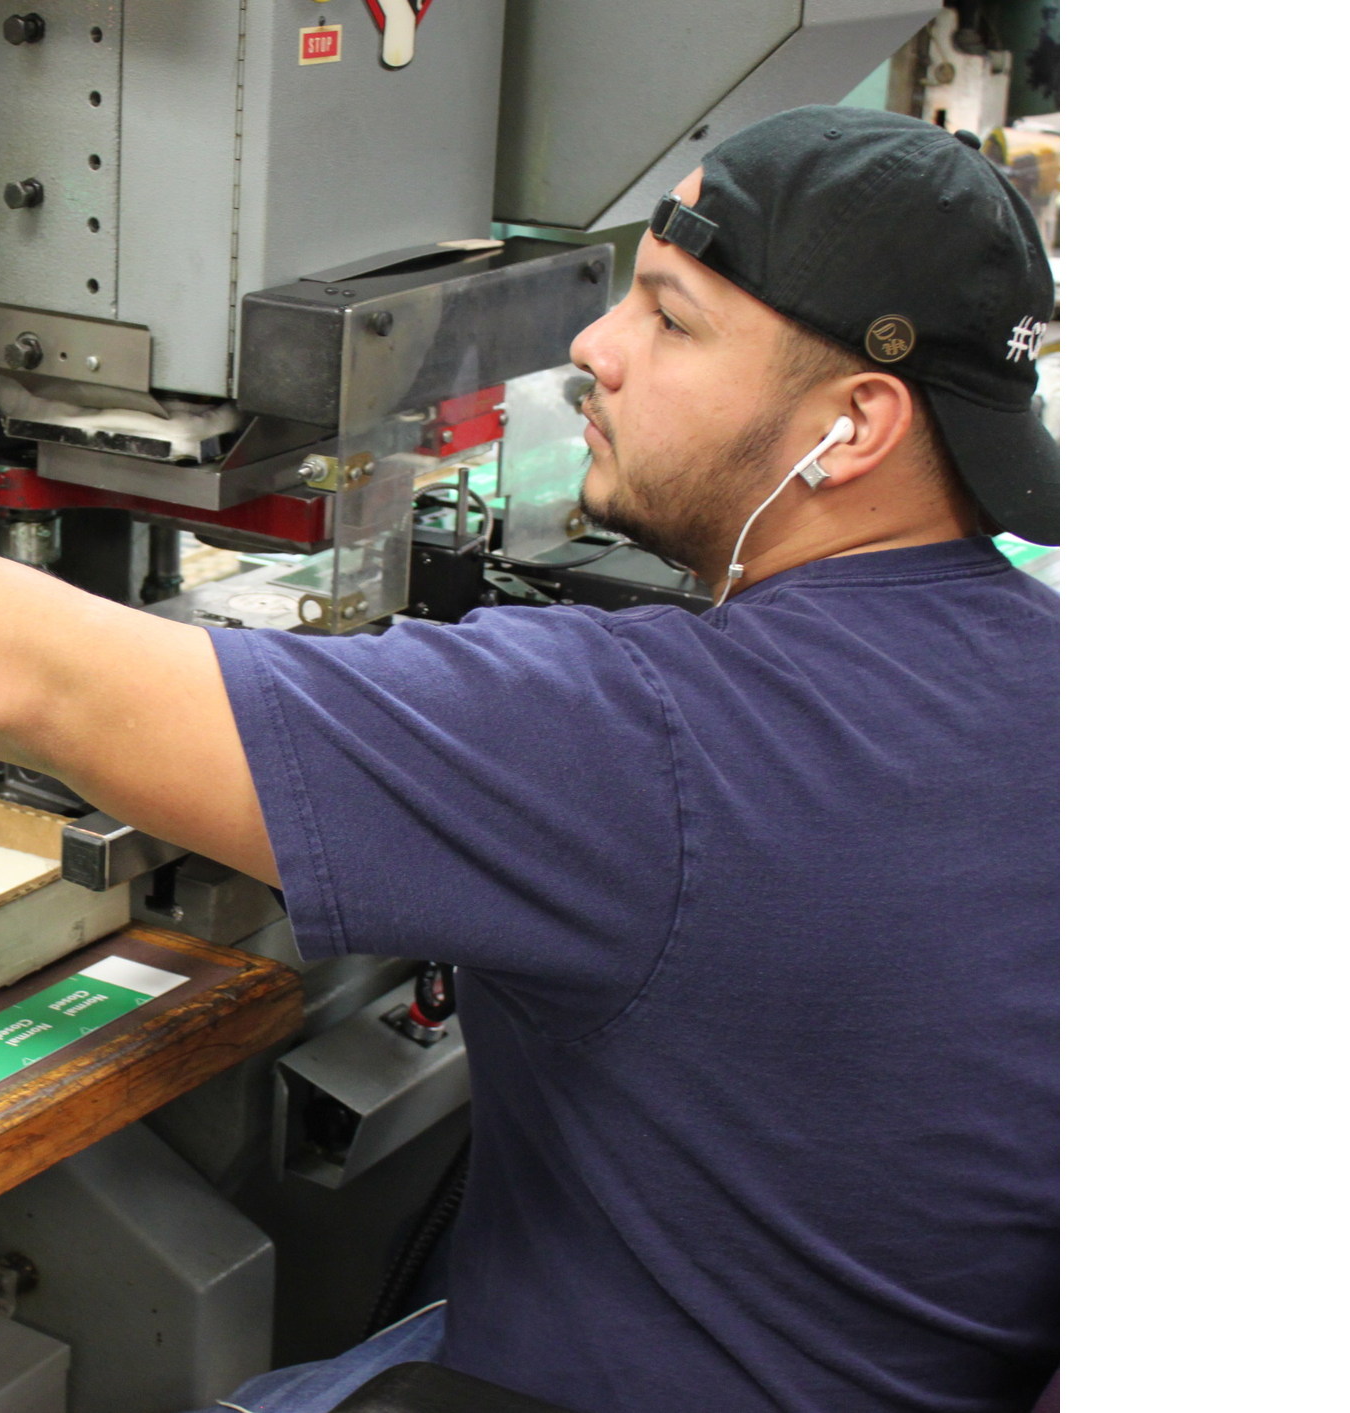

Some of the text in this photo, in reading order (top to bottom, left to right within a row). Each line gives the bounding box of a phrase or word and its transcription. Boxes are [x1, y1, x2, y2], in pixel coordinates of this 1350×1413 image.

[307, 36, 333, 54] STOP
[48, 990, 90, 1012] Closed
[62, 993, 109, 1017] Normal
[4, 1022, 53, 1047] Normal
